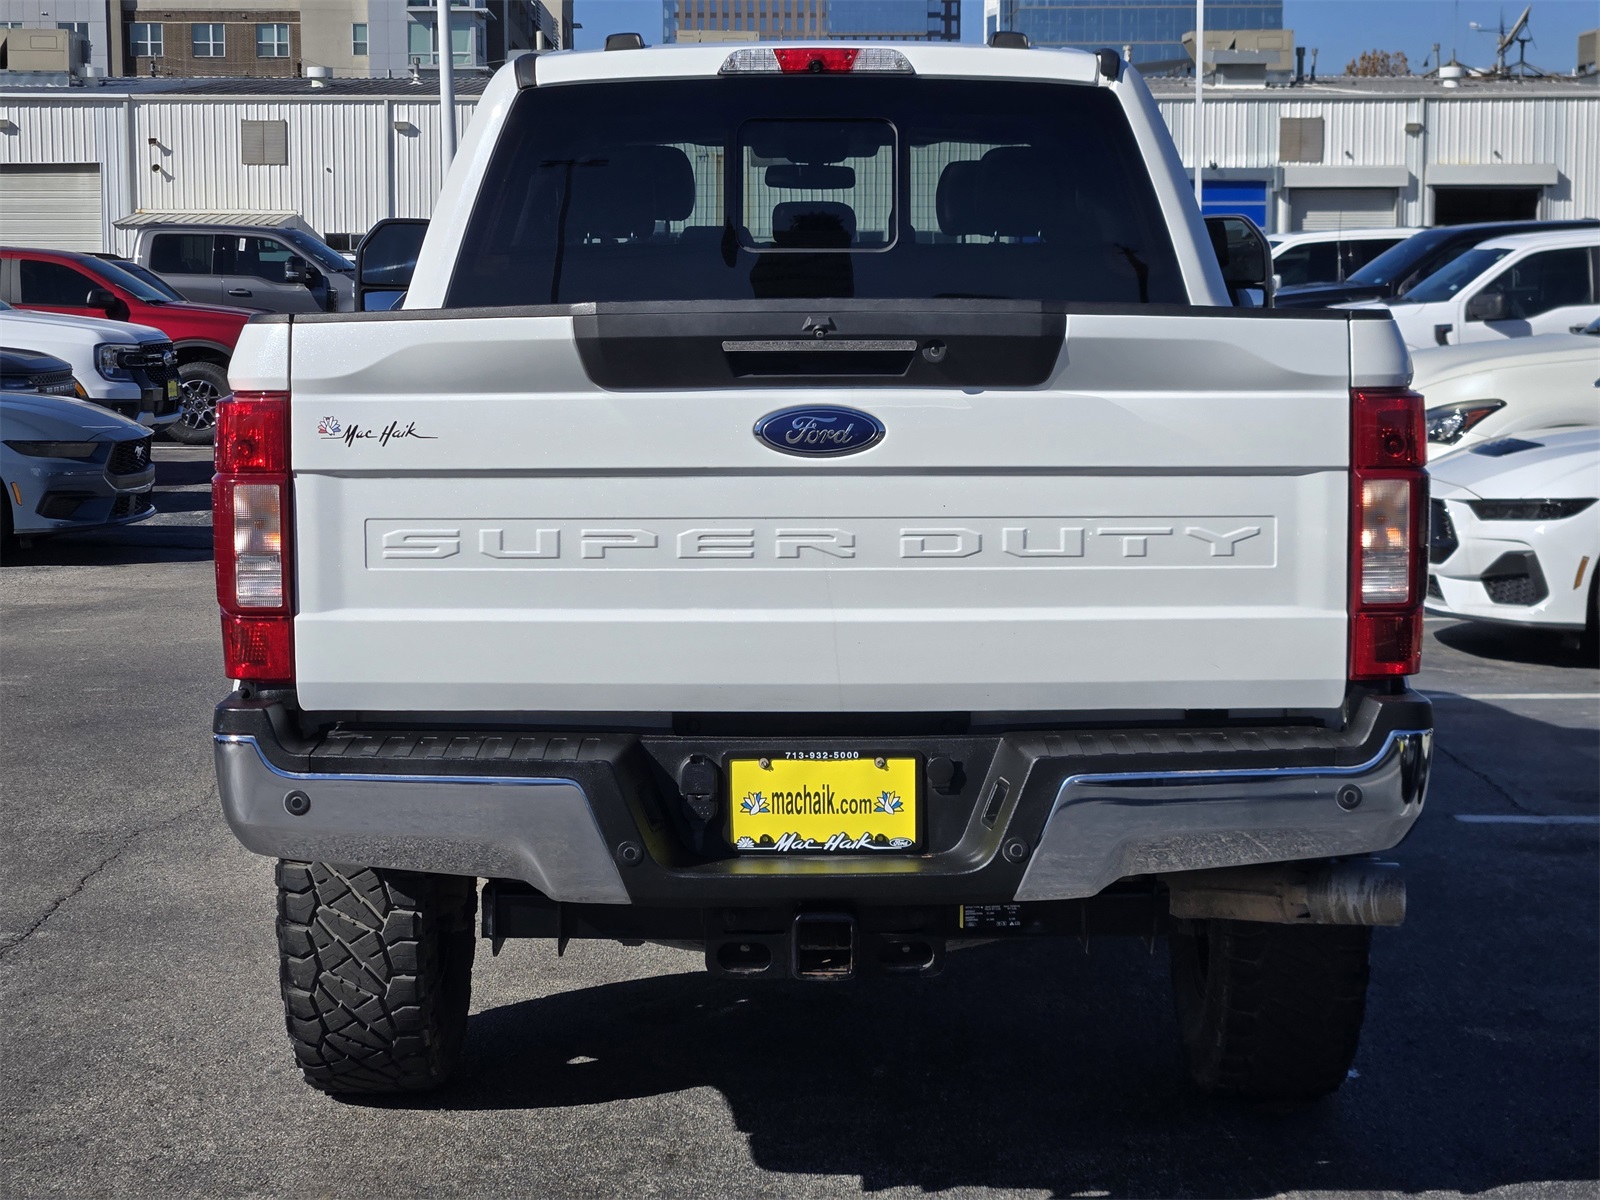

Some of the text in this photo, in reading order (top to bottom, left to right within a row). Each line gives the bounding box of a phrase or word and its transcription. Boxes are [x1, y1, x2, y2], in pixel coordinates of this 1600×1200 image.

[336, 420, 427, 448] Mac Haik
[785, 415, 855, 444] Ford
[382, 526, 1261, 559] SUPER DUTY
[785, 751, 859, 760] 713-932-5000
[771, 784, 872, 815] machaik.com
[773, 831, 874, 852] Mac Haik
